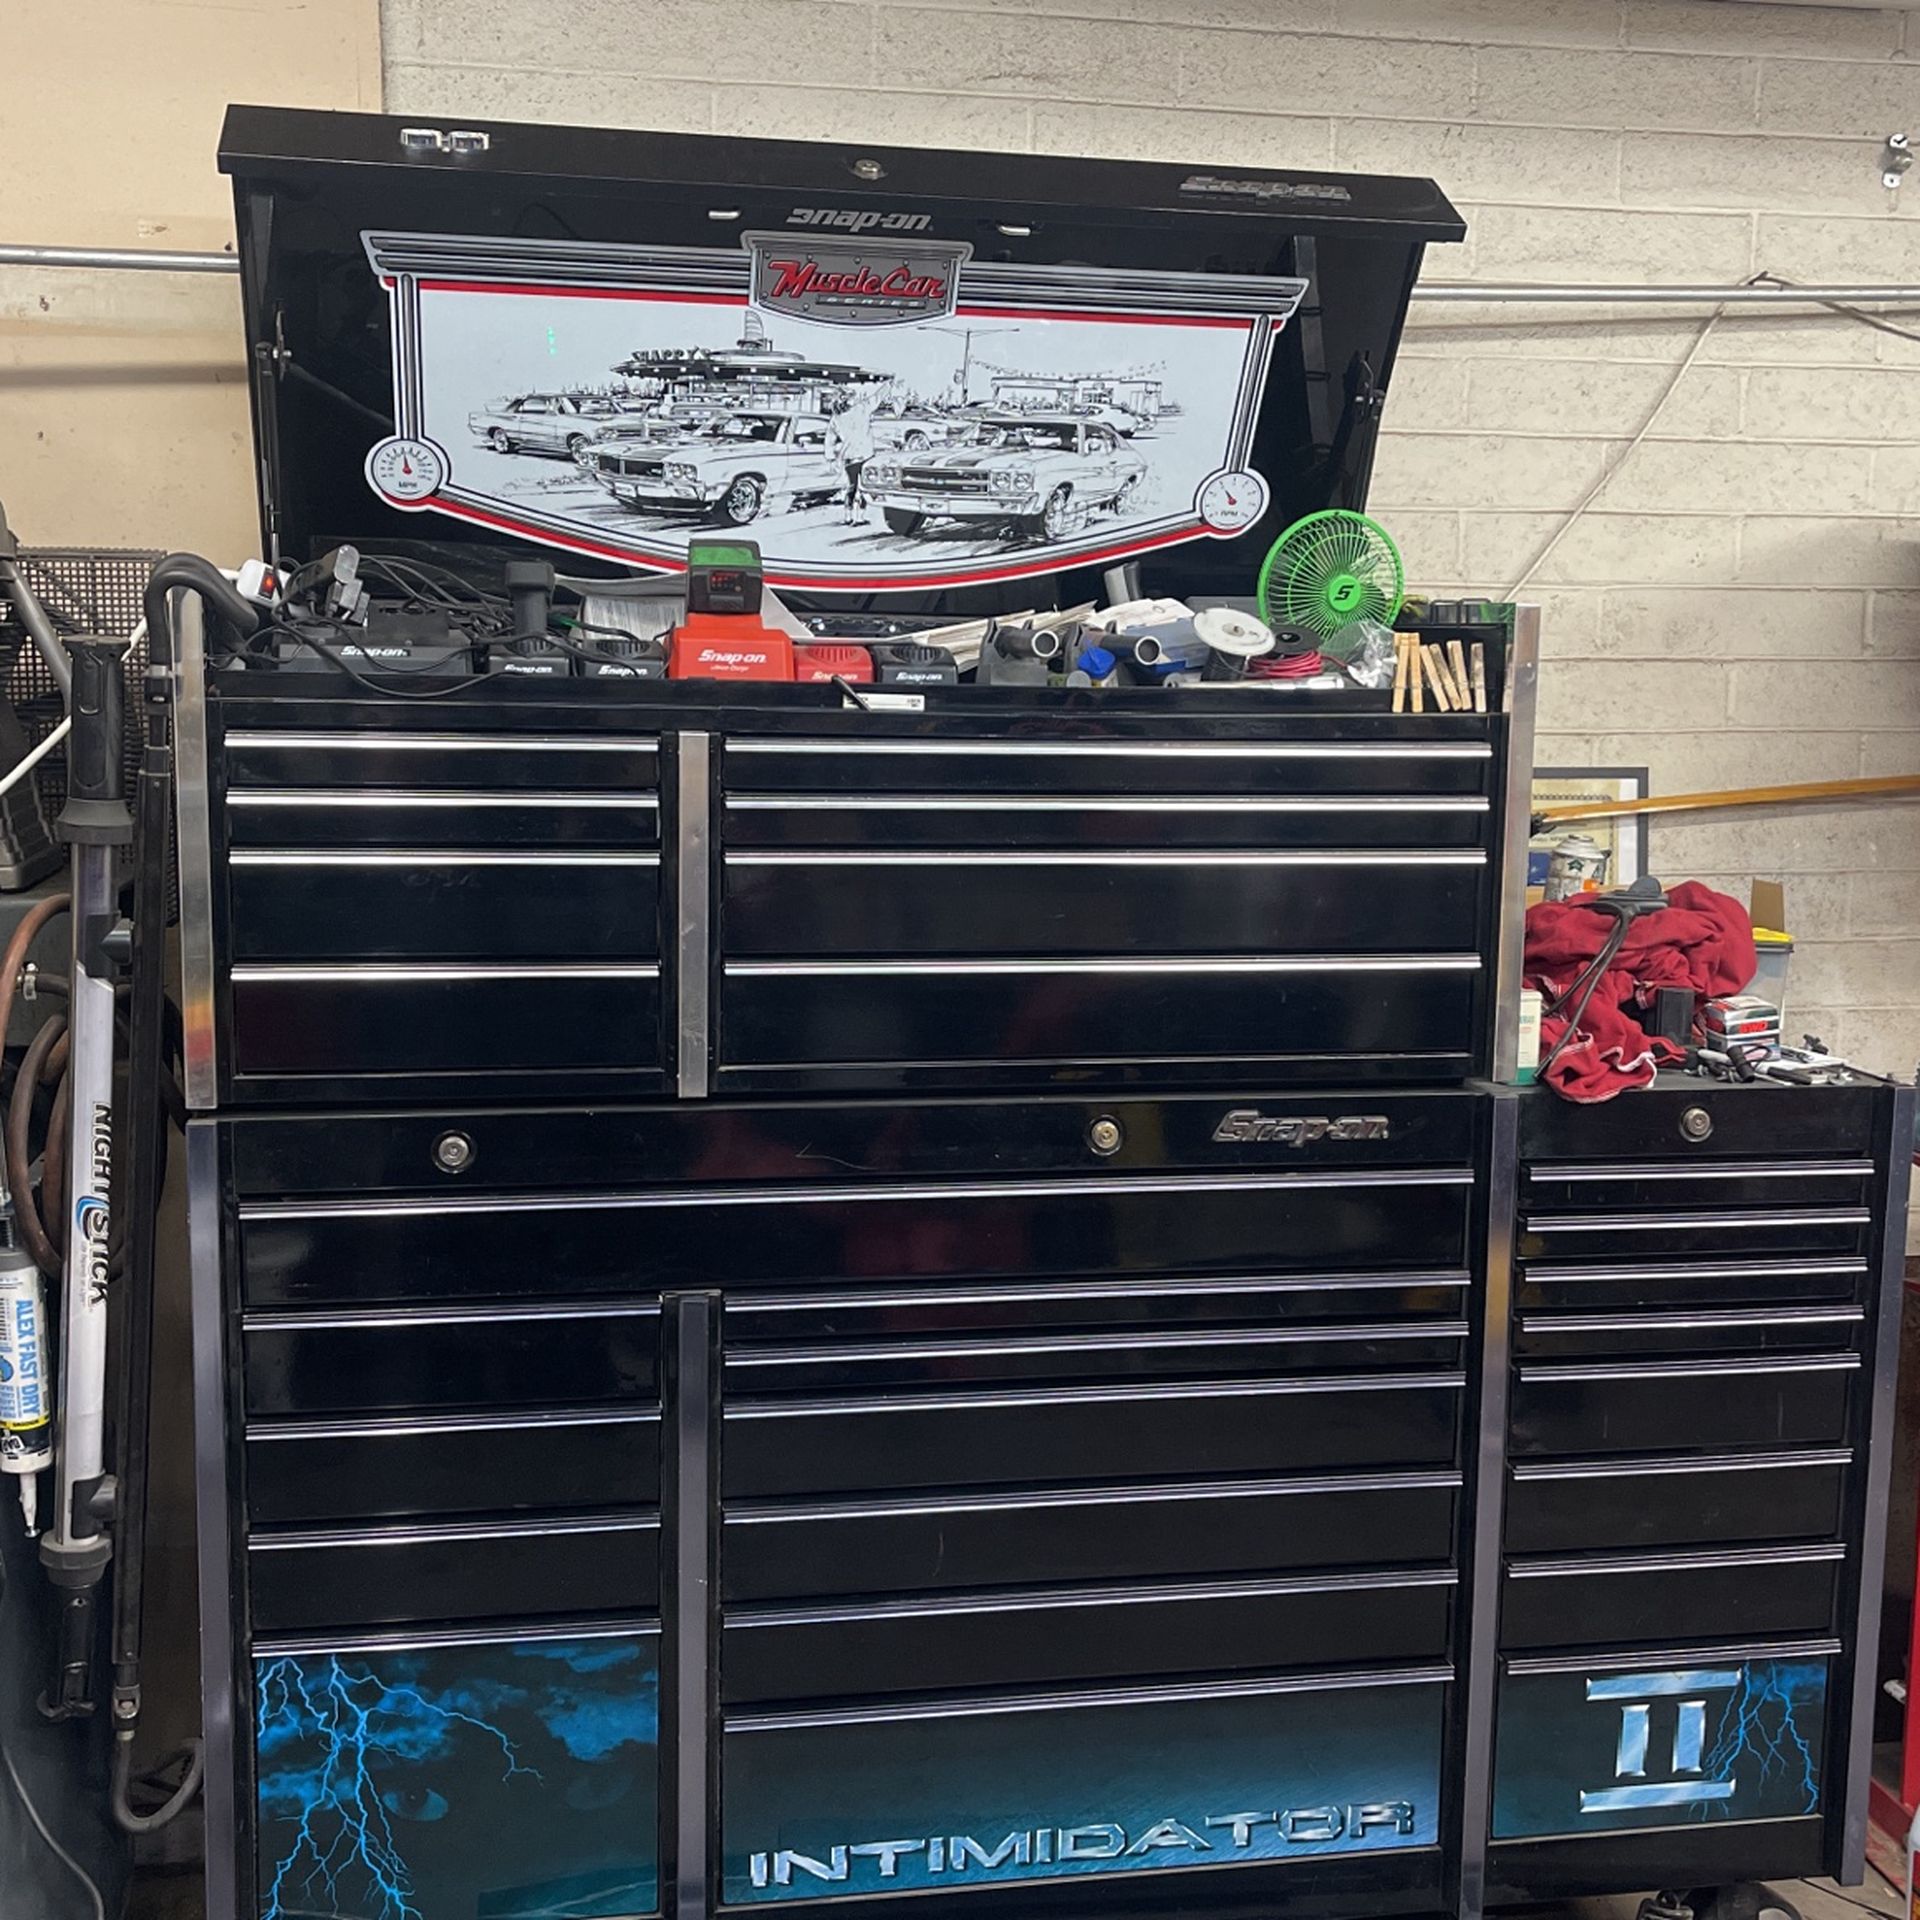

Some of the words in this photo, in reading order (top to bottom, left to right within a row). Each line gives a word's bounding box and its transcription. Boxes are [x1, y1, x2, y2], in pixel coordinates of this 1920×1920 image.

[698, 649, 766, 664] Snap-on
[895, 671, 942, 681] Snap-on
[1211, 1109, 1389, 1148] Snap-on
[16, 1300, 34, 1339] ALEX
[19, 1341, 37, 1379] FAST
[22, 1383, 40, 1413] DRY
[749, 1801, 1413, 1888] INTIMIDATOR
